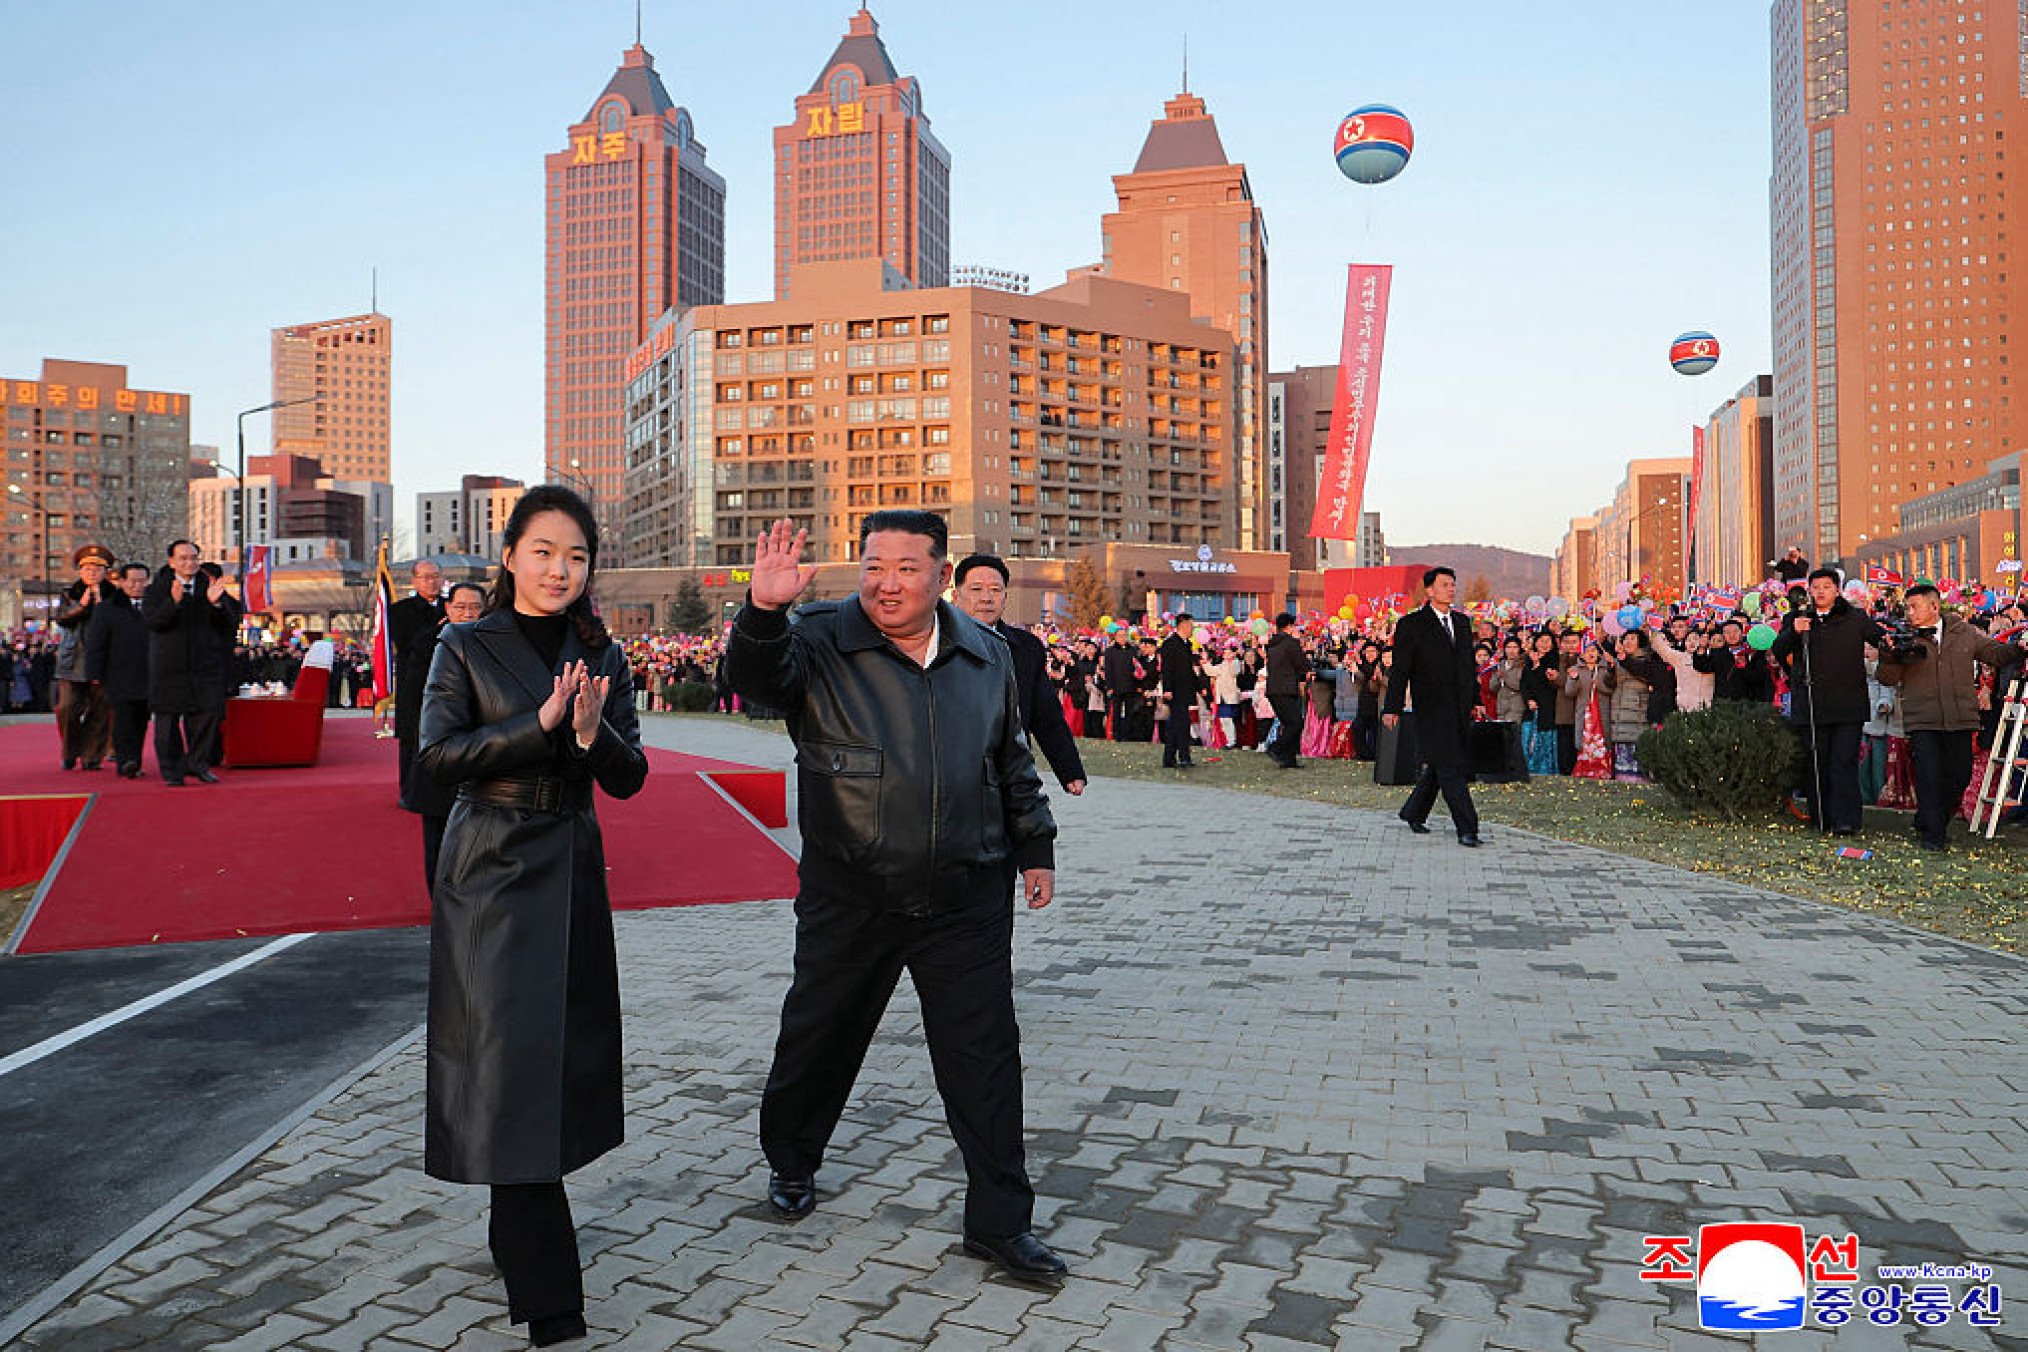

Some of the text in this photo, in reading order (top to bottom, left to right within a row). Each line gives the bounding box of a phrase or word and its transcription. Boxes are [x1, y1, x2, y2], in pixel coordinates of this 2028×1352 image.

[806, 101, 866, 138] 자립
[572, 131, 626, 165] 자주
[115, 388, 182, 416] 만세!
